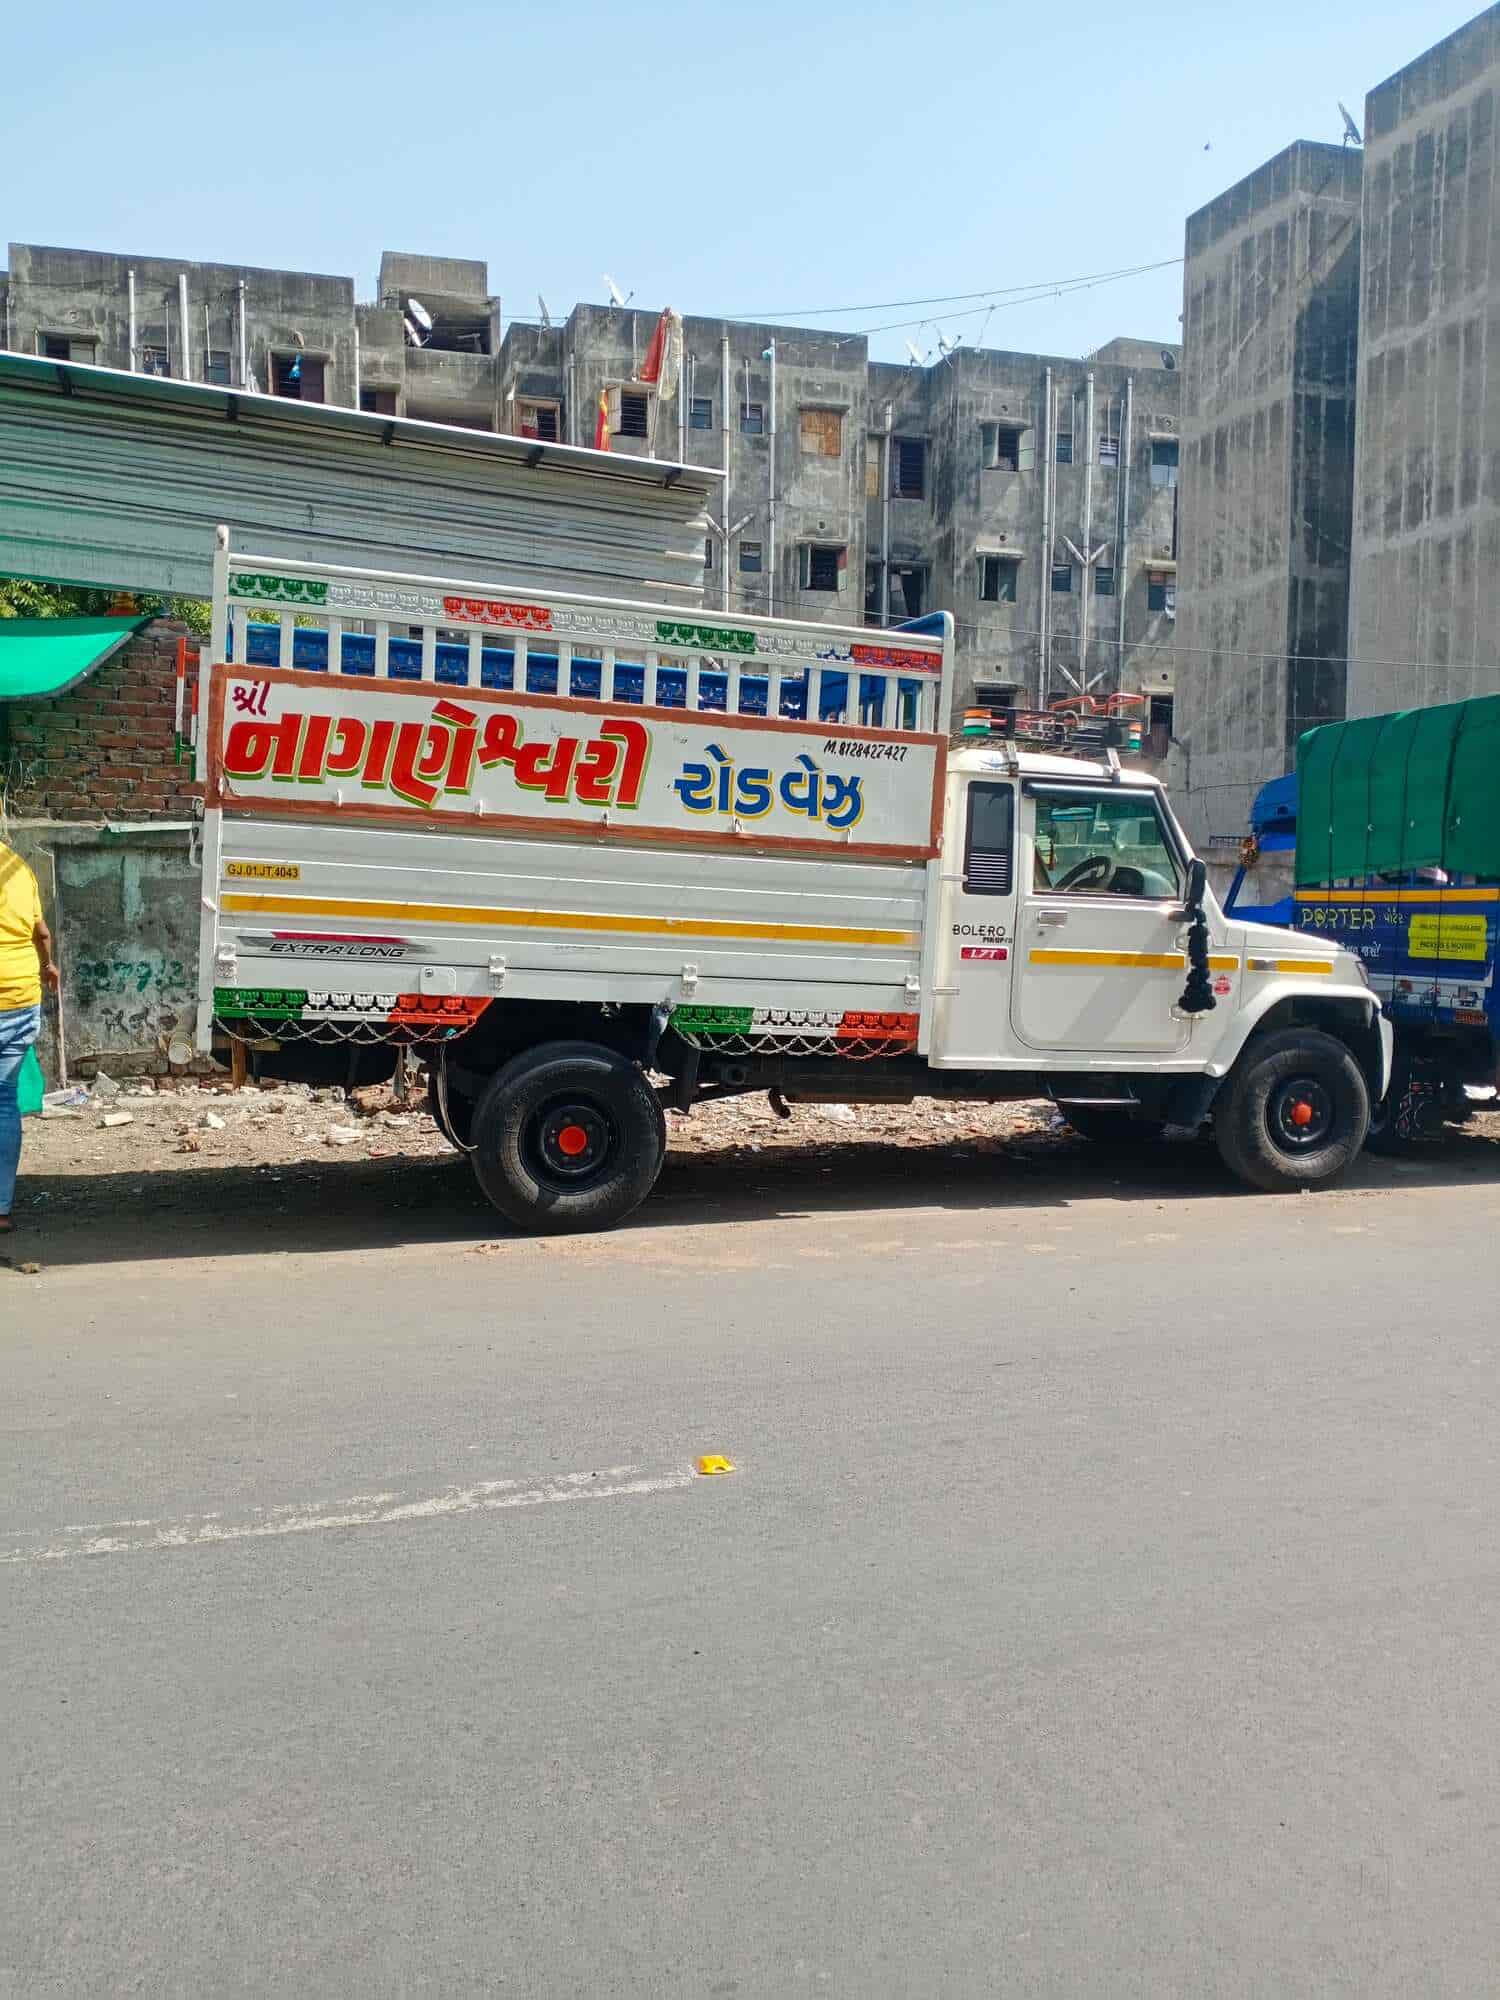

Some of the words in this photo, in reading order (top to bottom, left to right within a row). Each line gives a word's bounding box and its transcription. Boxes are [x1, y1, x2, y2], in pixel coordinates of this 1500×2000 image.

[232, 681, 271, 716] શ્રી
[224, 700, 653, 810] નાગણેશ્વરી
[1301, 908, 1376, 929] PORTER
[952, 924, 1006, 937] BOLERO
[269, 943, 347, 956] EXTRA
[348, 945, 406, 957] LONG
